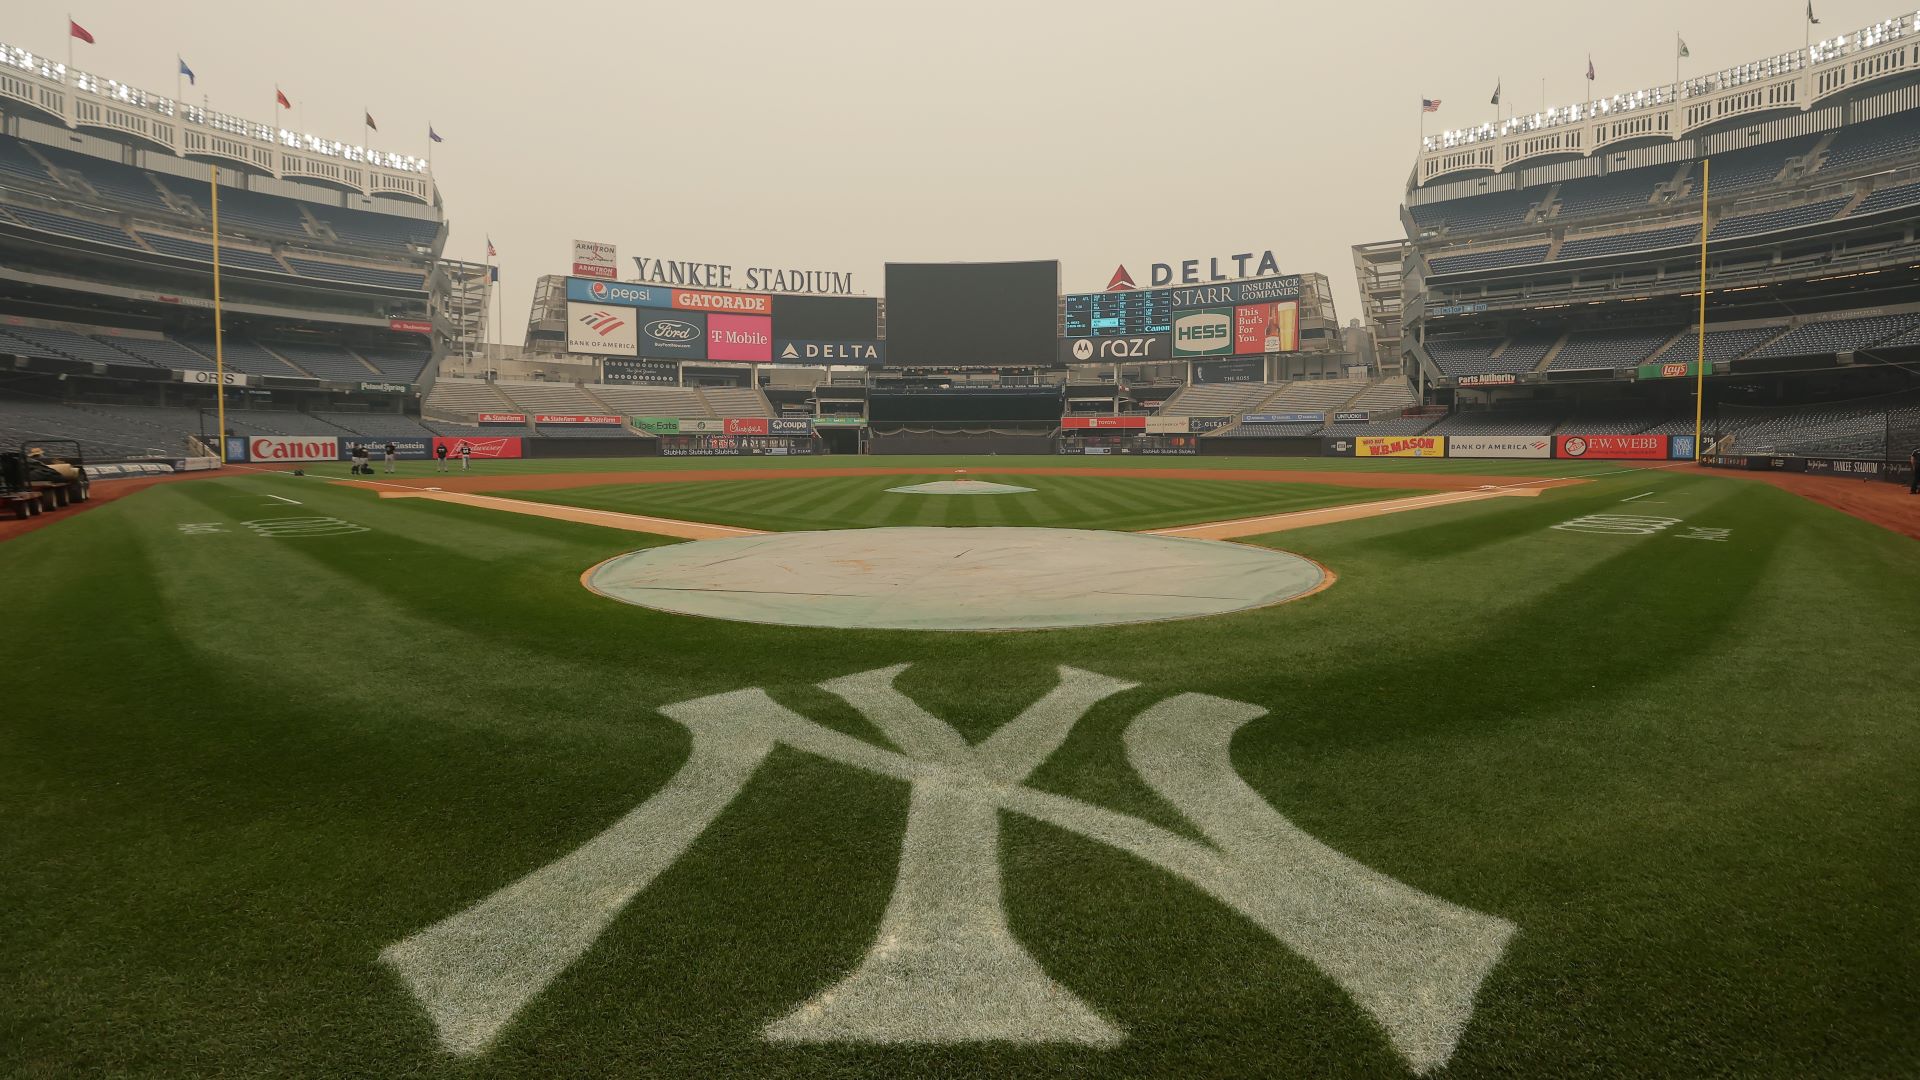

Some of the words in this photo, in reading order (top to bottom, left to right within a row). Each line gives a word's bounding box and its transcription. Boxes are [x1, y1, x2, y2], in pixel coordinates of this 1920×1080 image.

[632, 256, 731, 288] YANKEE
[746, 267, 852, 294] STADIUM
[1151, 250, 1280, 286] DELTA
[1241, 277, 1299, 293] INSURANCE
[610, 288, 650, 301] pepsi
[1172, 286, 1235, 306] STARR
[1241, 286, 1299, 301] COMPANIES
[678, 292, 765, 310] GATORADE
[1238, 308, 1259, 318] This
[1238, 316, 1264, 326] Bud's
[654, 322, 691, 339] Ford
[1178, 323, 1228, 341] HESS
[1239, 327, 1254, 335] For
[725, 331, 768, 345] Mobile
[1238, 336, 1259, 344] You.
[806, 344, 878, 358] DELTA
[1100, 338, 1156, 358] razr
[196, 371, 236, 385] ORS
[1479, 373, 1516, 382] Authority
[782, 420, 806, 429] coupa
[252, 439, 335, 459] Canon
[1616, 439, 1658, 449] WEBB
[1833, 460, 1852, 471] YANKEE
[1853, 462, 1878, 473] STADIUM
